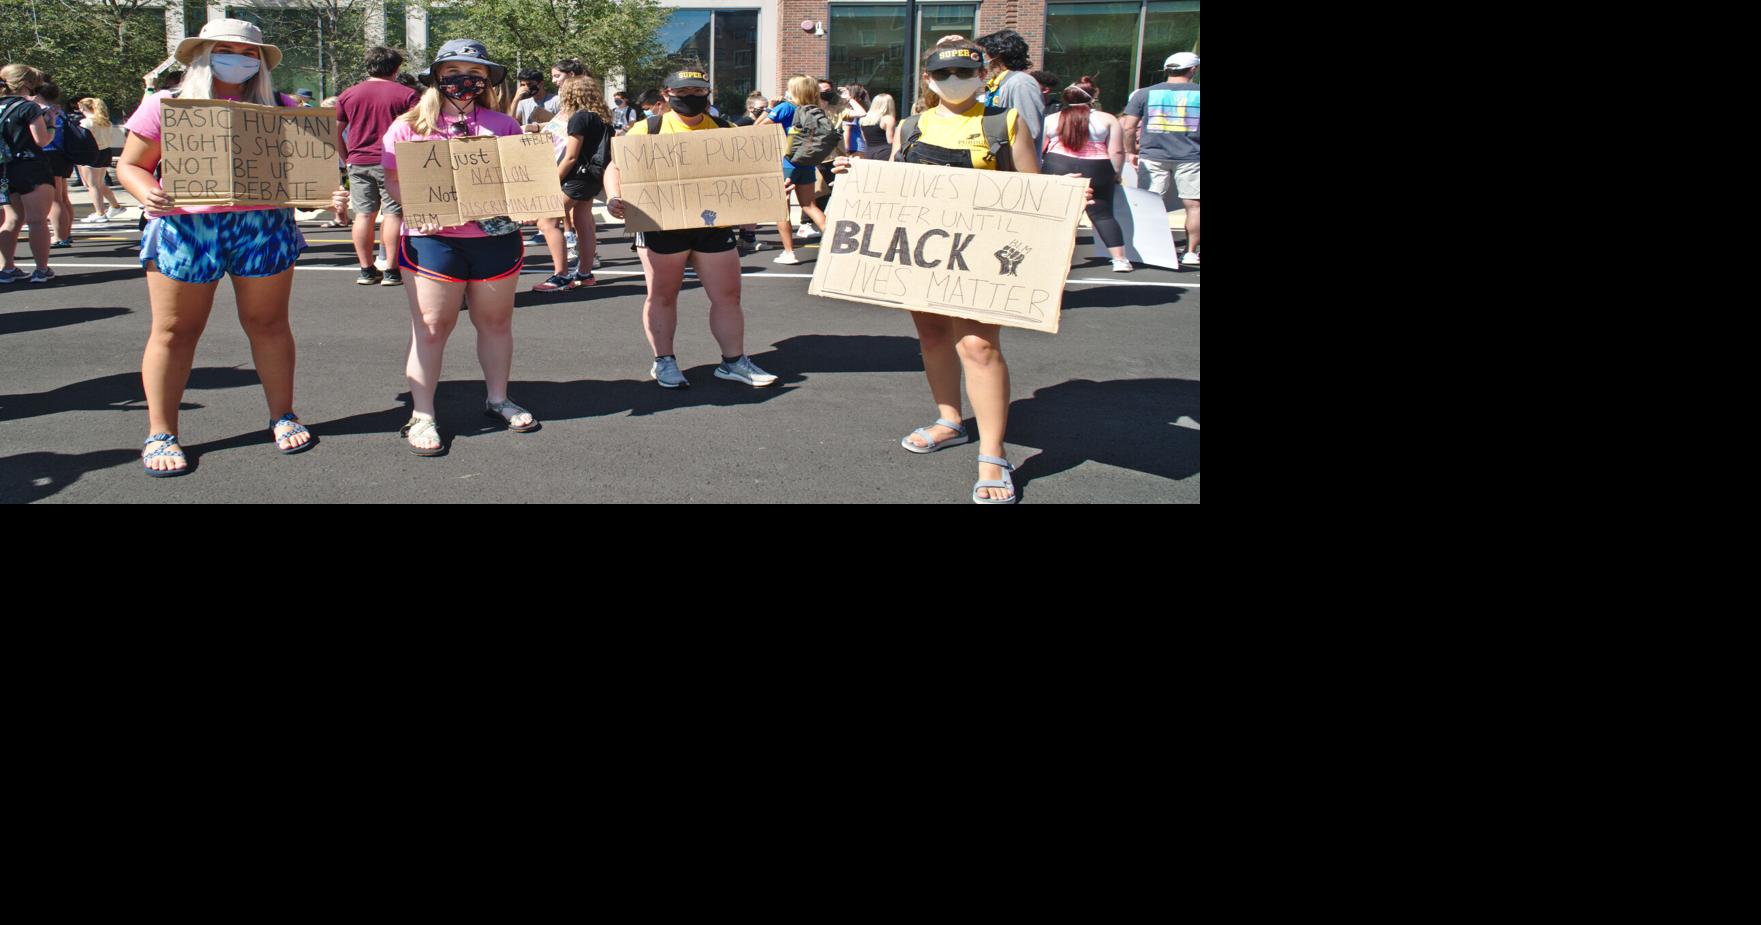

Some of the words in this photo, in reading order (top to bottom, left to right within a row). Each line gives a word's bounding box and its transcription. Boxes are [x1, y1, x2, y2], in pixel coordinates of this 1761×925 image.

[939, 49, 970, 60] SUPER
[678, 71, 703, 79] SUPER
[164, 109, 232, 128] BASIC
[244, 112, 331, 136] HUMAN
[164, 133, 241, 155] RIGHTS
[253, 137, 336, 160] SHOULD
[422, 144, 442, 169] A
[451, 148, 490, 171] just
[624, 142, 691, 170] MAKE
[164, 157, 218, 176] NOT
[233, 157, 258, 179] BE
[271, 161, 295, 180] UP
[471, 166, 529, 184] NATION
[173, 179, 219, 200] FOR
[232, 181, 318, 201] DEBATE
[428, 186, 459, 203] Not
[637, 176, 784, 212] ANTI-RACIST
[843, 165, 886, 194] ALL
[900, 169, 961, 199] LIVES
[973, 173, 1087, 216] DON'T
[460, 195, 564, 215] DISCRIMINATION
[842, 200, 930, 226] MATTER
[940, 209, 1019, 234] UNTIL
[830, 220, 976, 271] BLACK
[822, 257, 912, 296] LIVES
[926, 271, 1051, 318] MATTER
